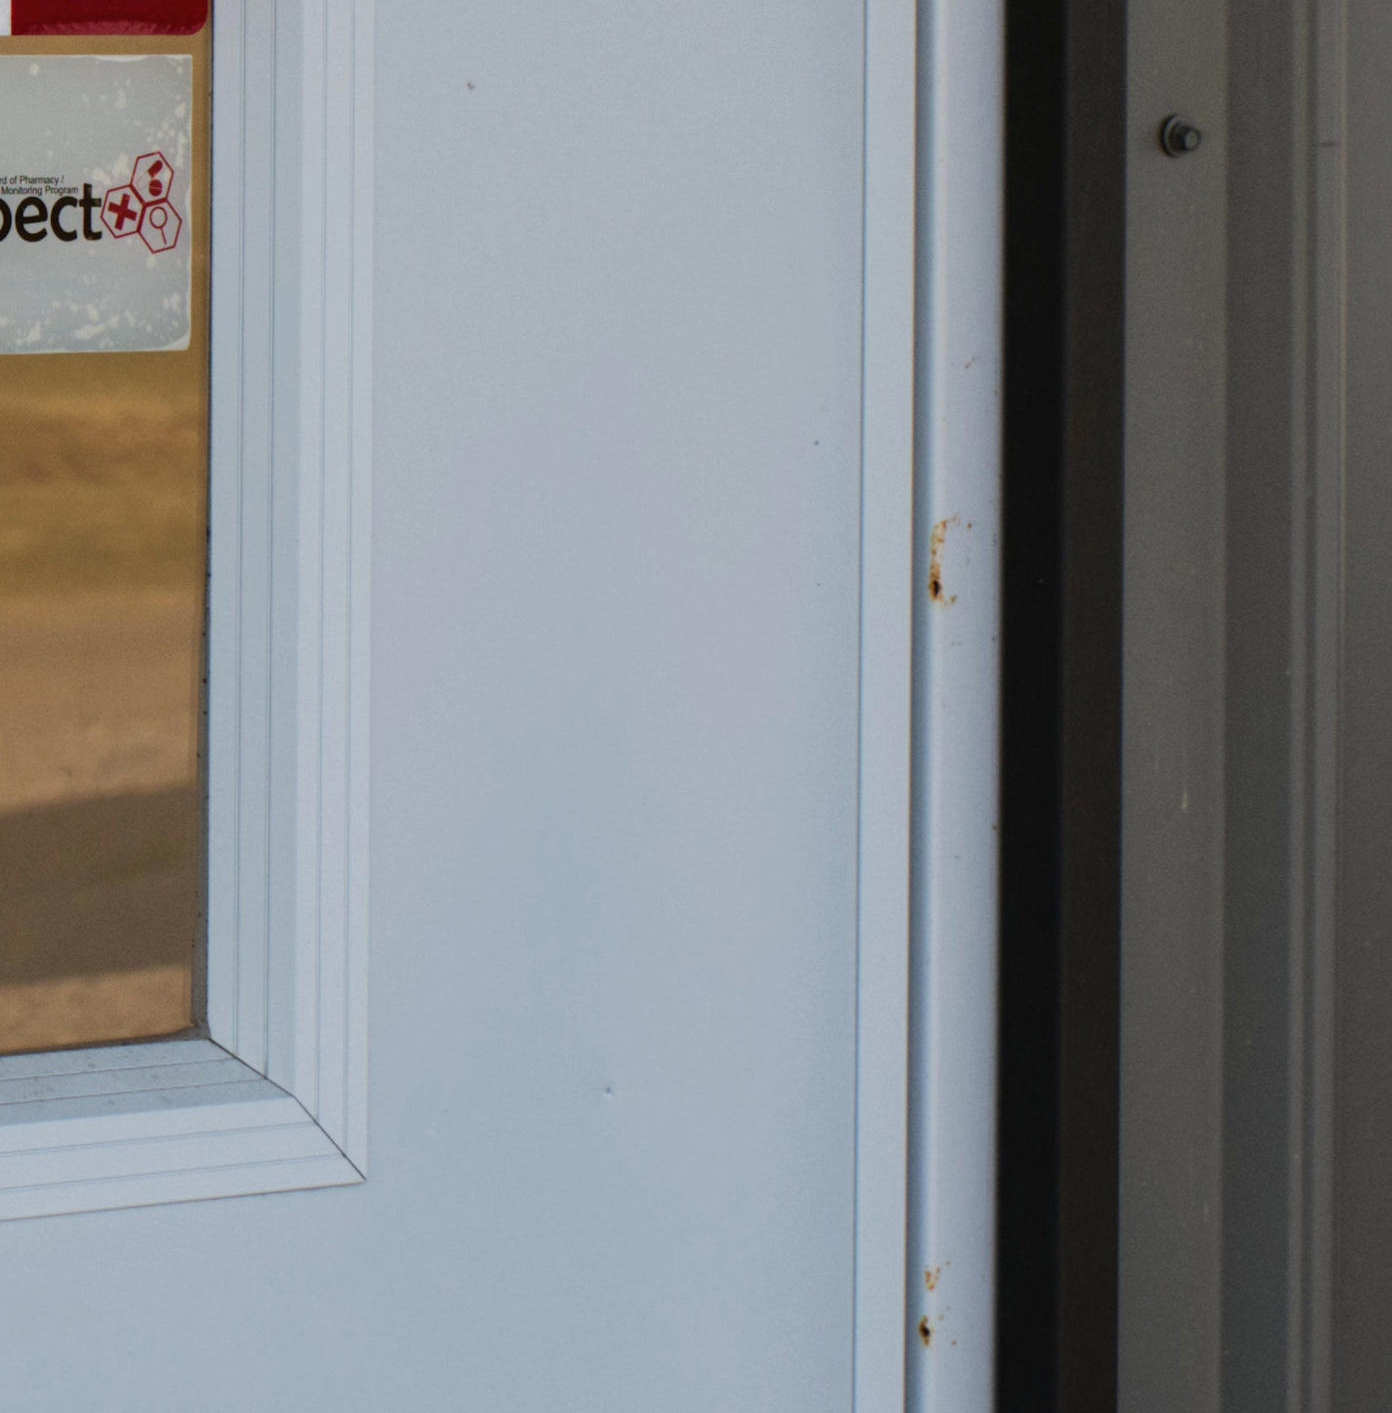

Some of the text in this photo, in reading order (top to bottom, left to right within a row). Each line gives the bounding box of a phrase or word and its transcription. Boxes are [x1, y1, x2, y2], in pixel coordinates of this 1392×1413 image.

[9, 176, 19, 185] of
[19, 176, 58, 187] Pharmacy
[1, 186, 43, 197] Monitoring
[45, 186, 79, 197] Program
